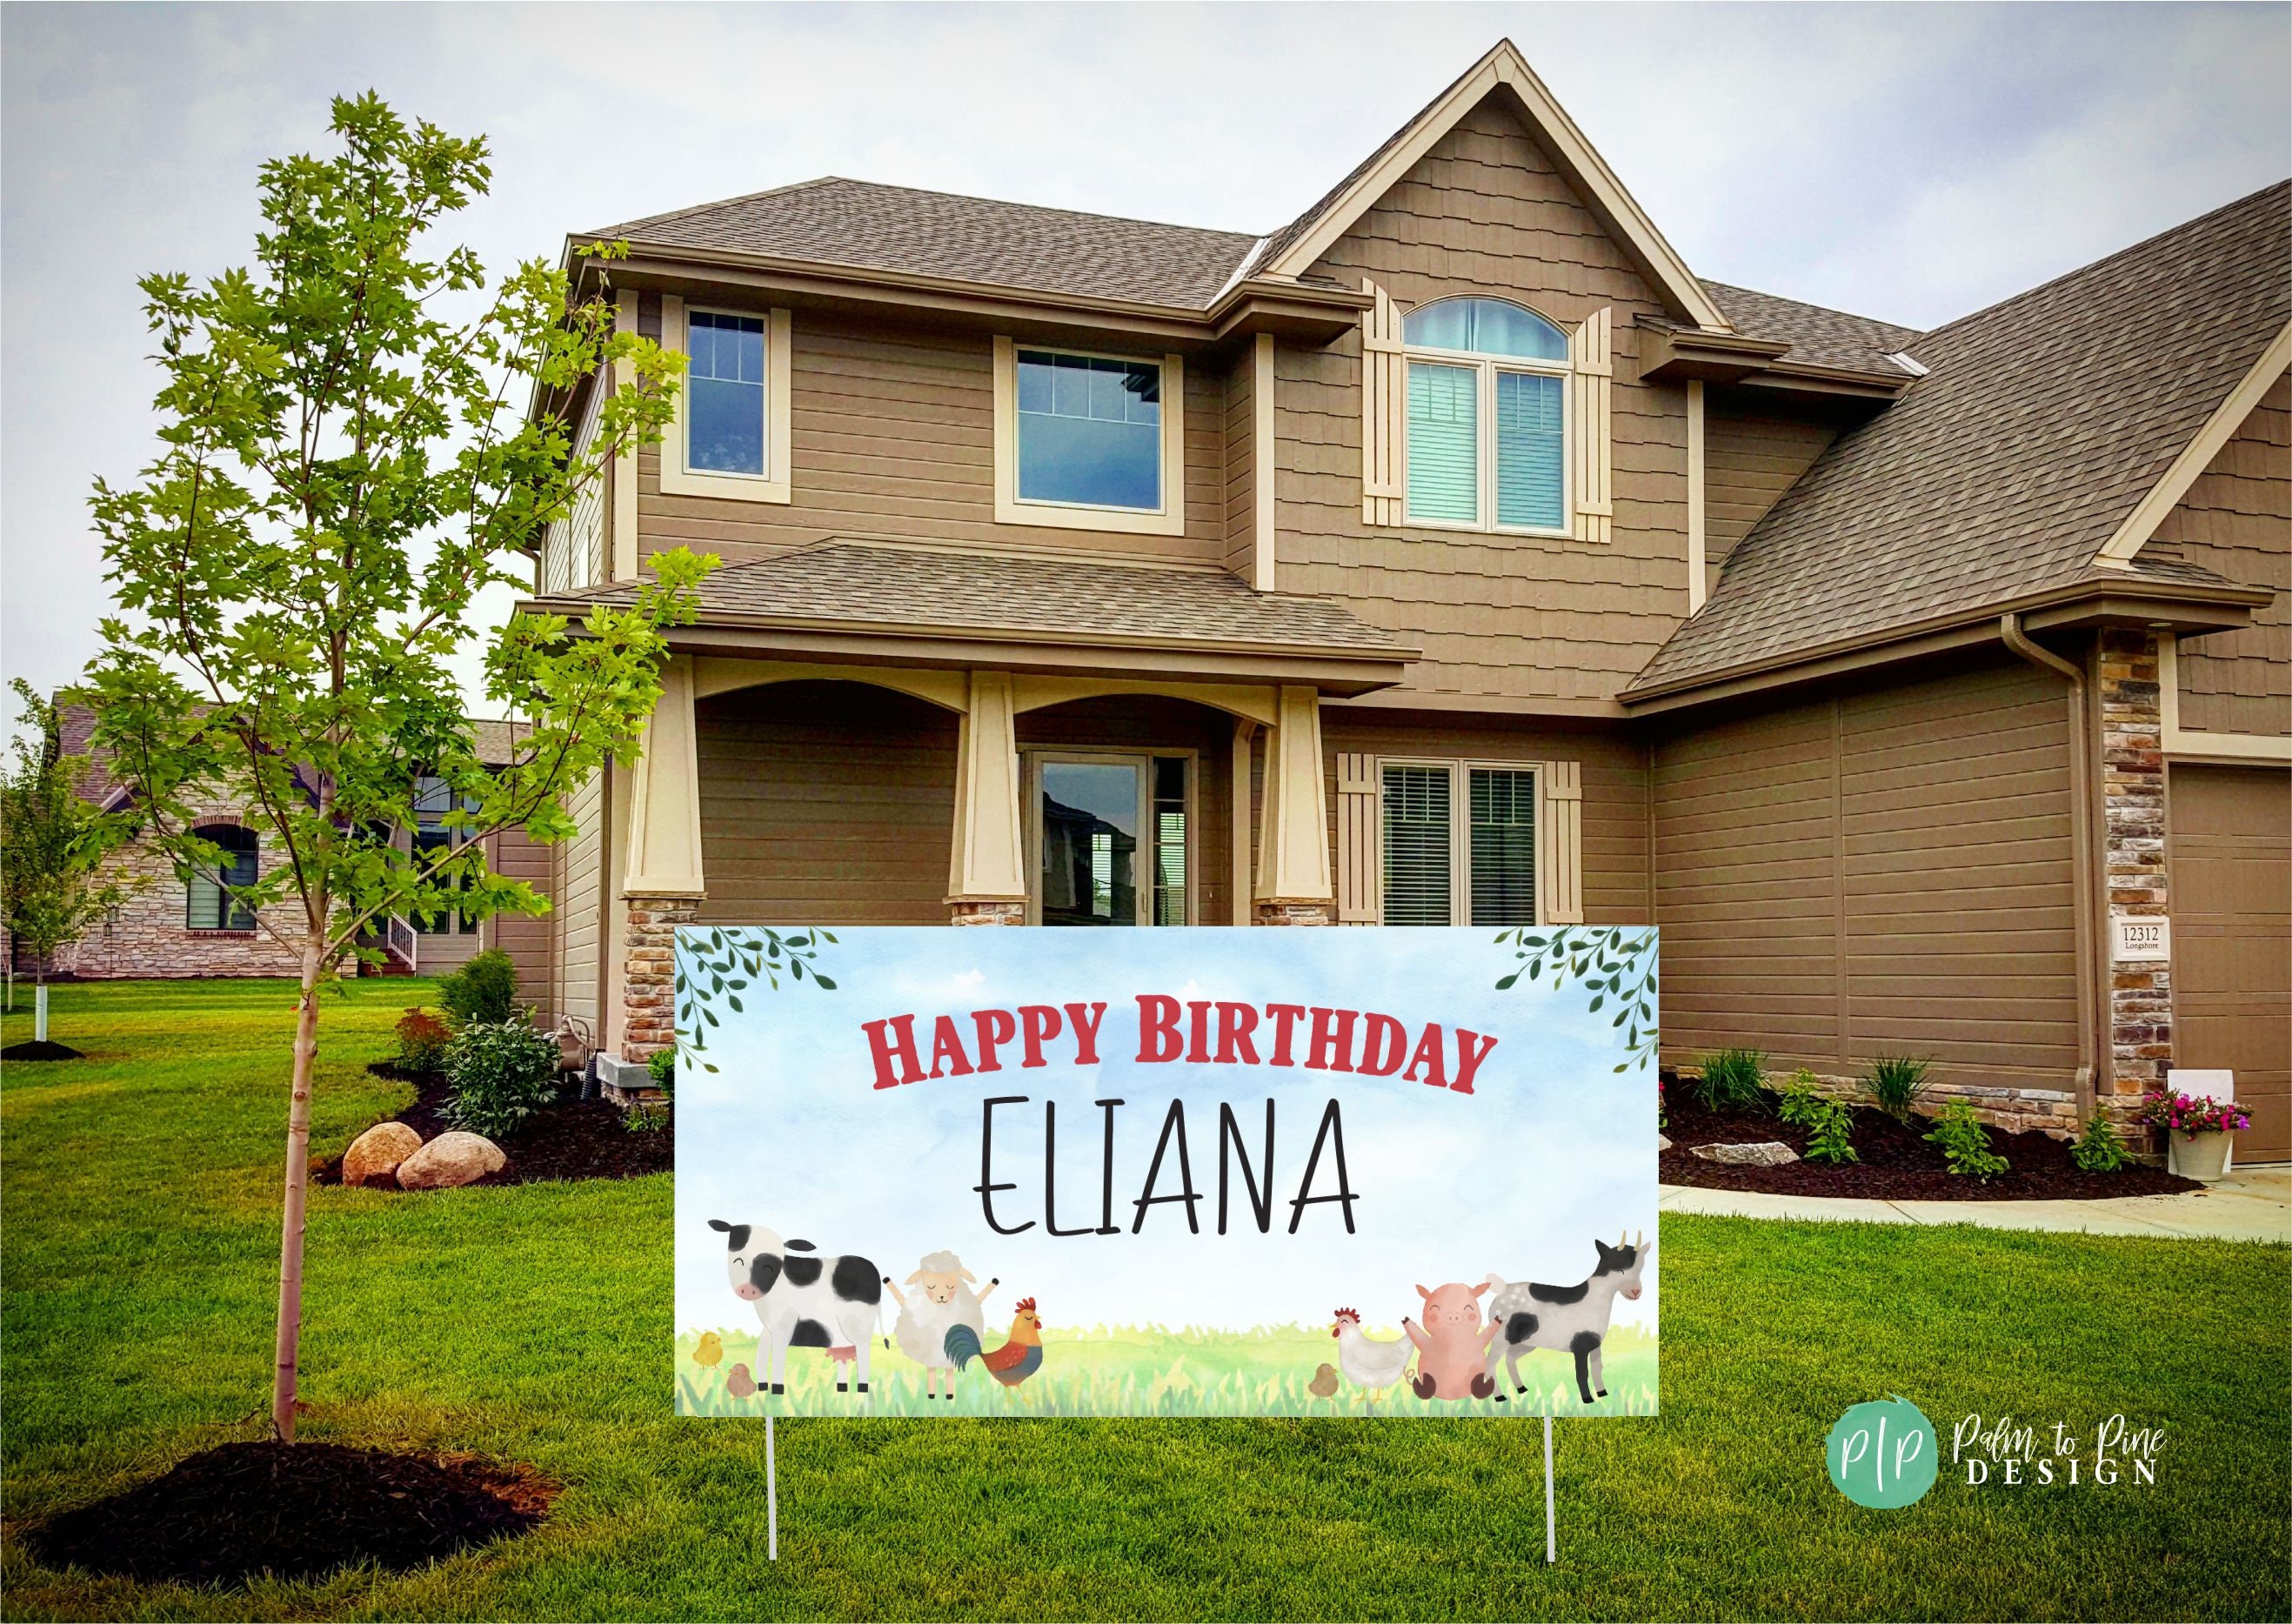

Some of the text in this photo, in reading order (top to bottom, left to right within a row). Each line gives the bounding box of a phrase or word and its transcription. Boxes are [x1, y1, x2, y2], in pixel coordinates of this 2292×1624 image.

[2124, 926, 2159, 941] 12312
[861, 994, 1499, 1095] HAPPY BIRTHDAY
[972, 1096, 1360, 1236] ELIANA
